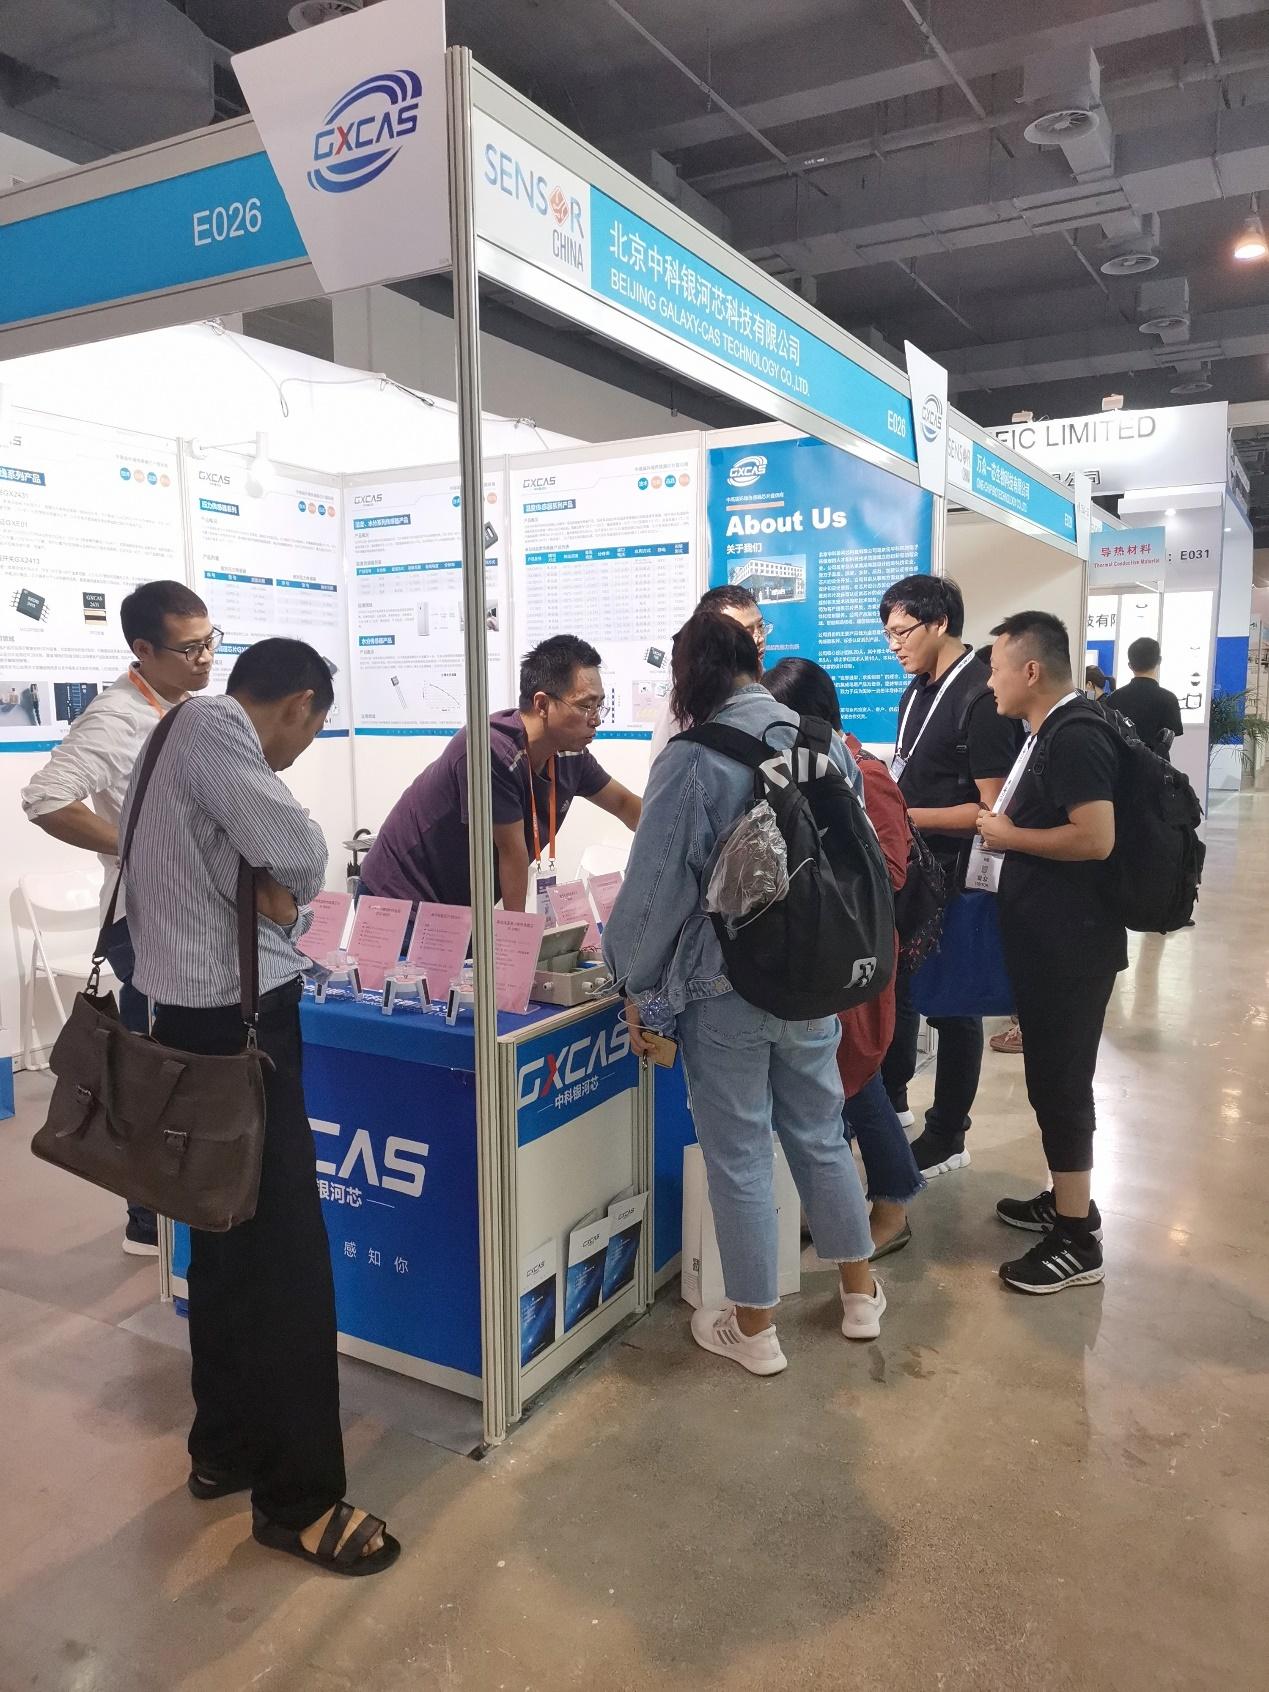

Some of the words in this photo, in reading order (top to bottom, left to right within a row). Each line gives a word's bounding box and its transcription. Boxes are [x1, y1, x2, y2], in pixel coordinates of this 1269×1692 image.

[313, 103, 418, 161] GXCAS
[193, 197, 261, 246] E026
[551, 229, 584, 271] CHINA
[609, 220, 800, 367] 北京中科银河芯科技有限公司
[611, 268, 656, 310] BEIJING
[659, 296, 721, 347] GALAXY-CAS
[722, 333, 780, 377] TECHNOLOGY
[887, 409, 906, 438] E026
[1045, 414, 1156, 448] LIMITED
[198, 471, 231, 484] GXCAS
[523, 477, 557, 488] GXCAS
[353, 494, 383, 505] GXCAS
[726, 510, 804, 537] About
[811, 507, 848, 529] Us
[726, 543, 763, 554] 关于我们
[1101, 543, 1152, 558] 导热材料
[1114, 559, 1140, 567] Conductive
[1180, 549, 1210, 561] E031
[516, 1021, 631, 1110] GXCAS
[554, 1075, 599, 1109] 中科银河芯
[344, 1241, 409, 1274] 感知你
